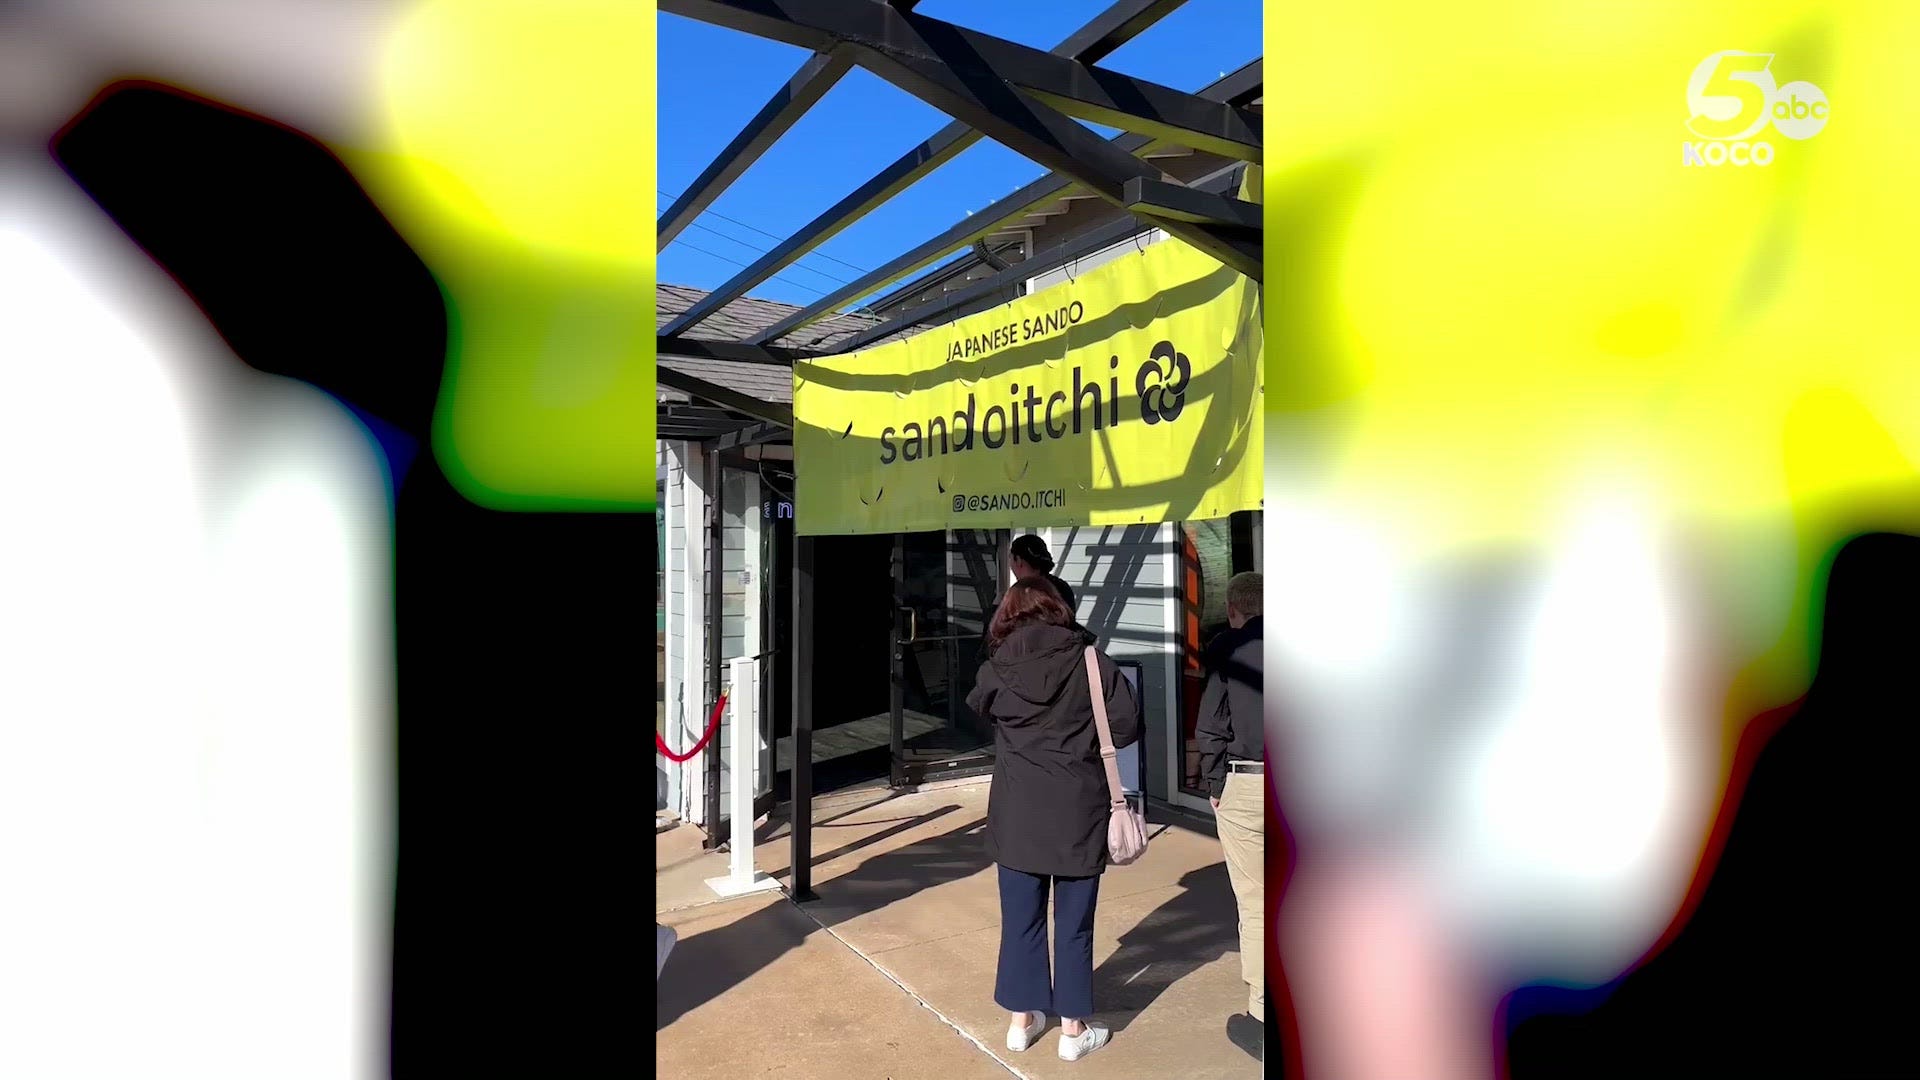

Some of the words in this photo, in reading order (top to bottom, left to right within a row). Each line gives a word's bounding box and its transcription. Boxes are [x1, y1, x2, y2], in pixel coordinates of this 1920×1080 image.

[946, 322, 1018, 362] JAPANESE
[1023, 300, 1084, 341] SANDO
[879, 354, 1120, 465] sandoitchi
[967, 488, 1066, 512] @SANDO.ITCHI
